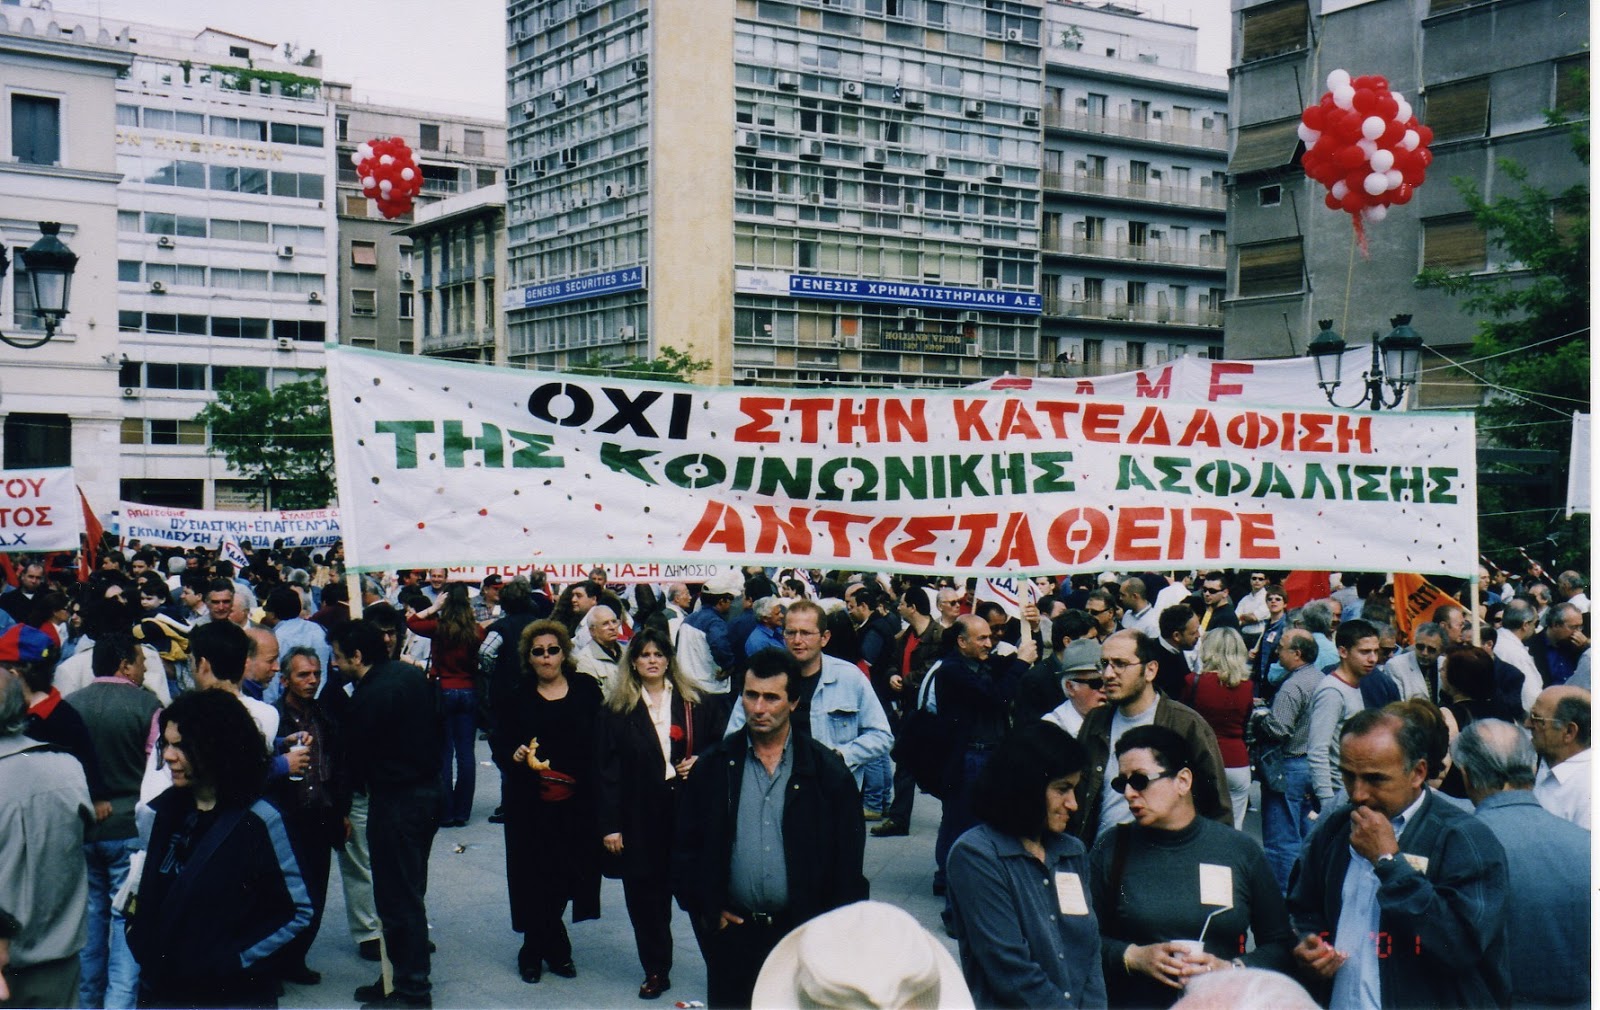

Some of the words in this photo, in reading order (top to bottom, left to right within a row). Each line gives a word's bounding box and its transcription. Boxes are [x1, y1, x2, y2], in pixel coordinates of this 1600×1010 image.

[526, 284, 561, 300] GENESIS
[565, 274, 617, 293] SECURITIES
[622, 270, 640, 283] S.A.
[791, 277, 858, 293] ΓΕΝΕΣΙΣ
[868, 283, 1005, 304] ΧΡΗΜΑΤΙΣΤΗΡΙΑΚΗ
[1014, 295, 1041, 307] Α.Ε.
[931, 334, 961, 345] VIDEO
[527, 382, 692, 440] ΟΧΙ
[733, 396, 929, 443] ΣΤΗΝ
[954, 398, 1372, 455] ΚΑΤΕΔΑΦΙΣΗ
[374, 420, 565, 468] ΤΗΣ
[600, 441, 1075, 502] ΚΟΙΝΩΝΙΚΗΣ
[1115, 453, 1459, 505] ΑΣΦΑΛΙΣΗΣ
[129, 526, 211, 544] ΕΚΠΑΙΔΕΥΣΗ
[682, 500, 1281, 568] ΑΝΤΙΣΤΑΘΕΙΤΕ
[664, 564, 718, 577] ΔΗΜΟΣΙΟ
